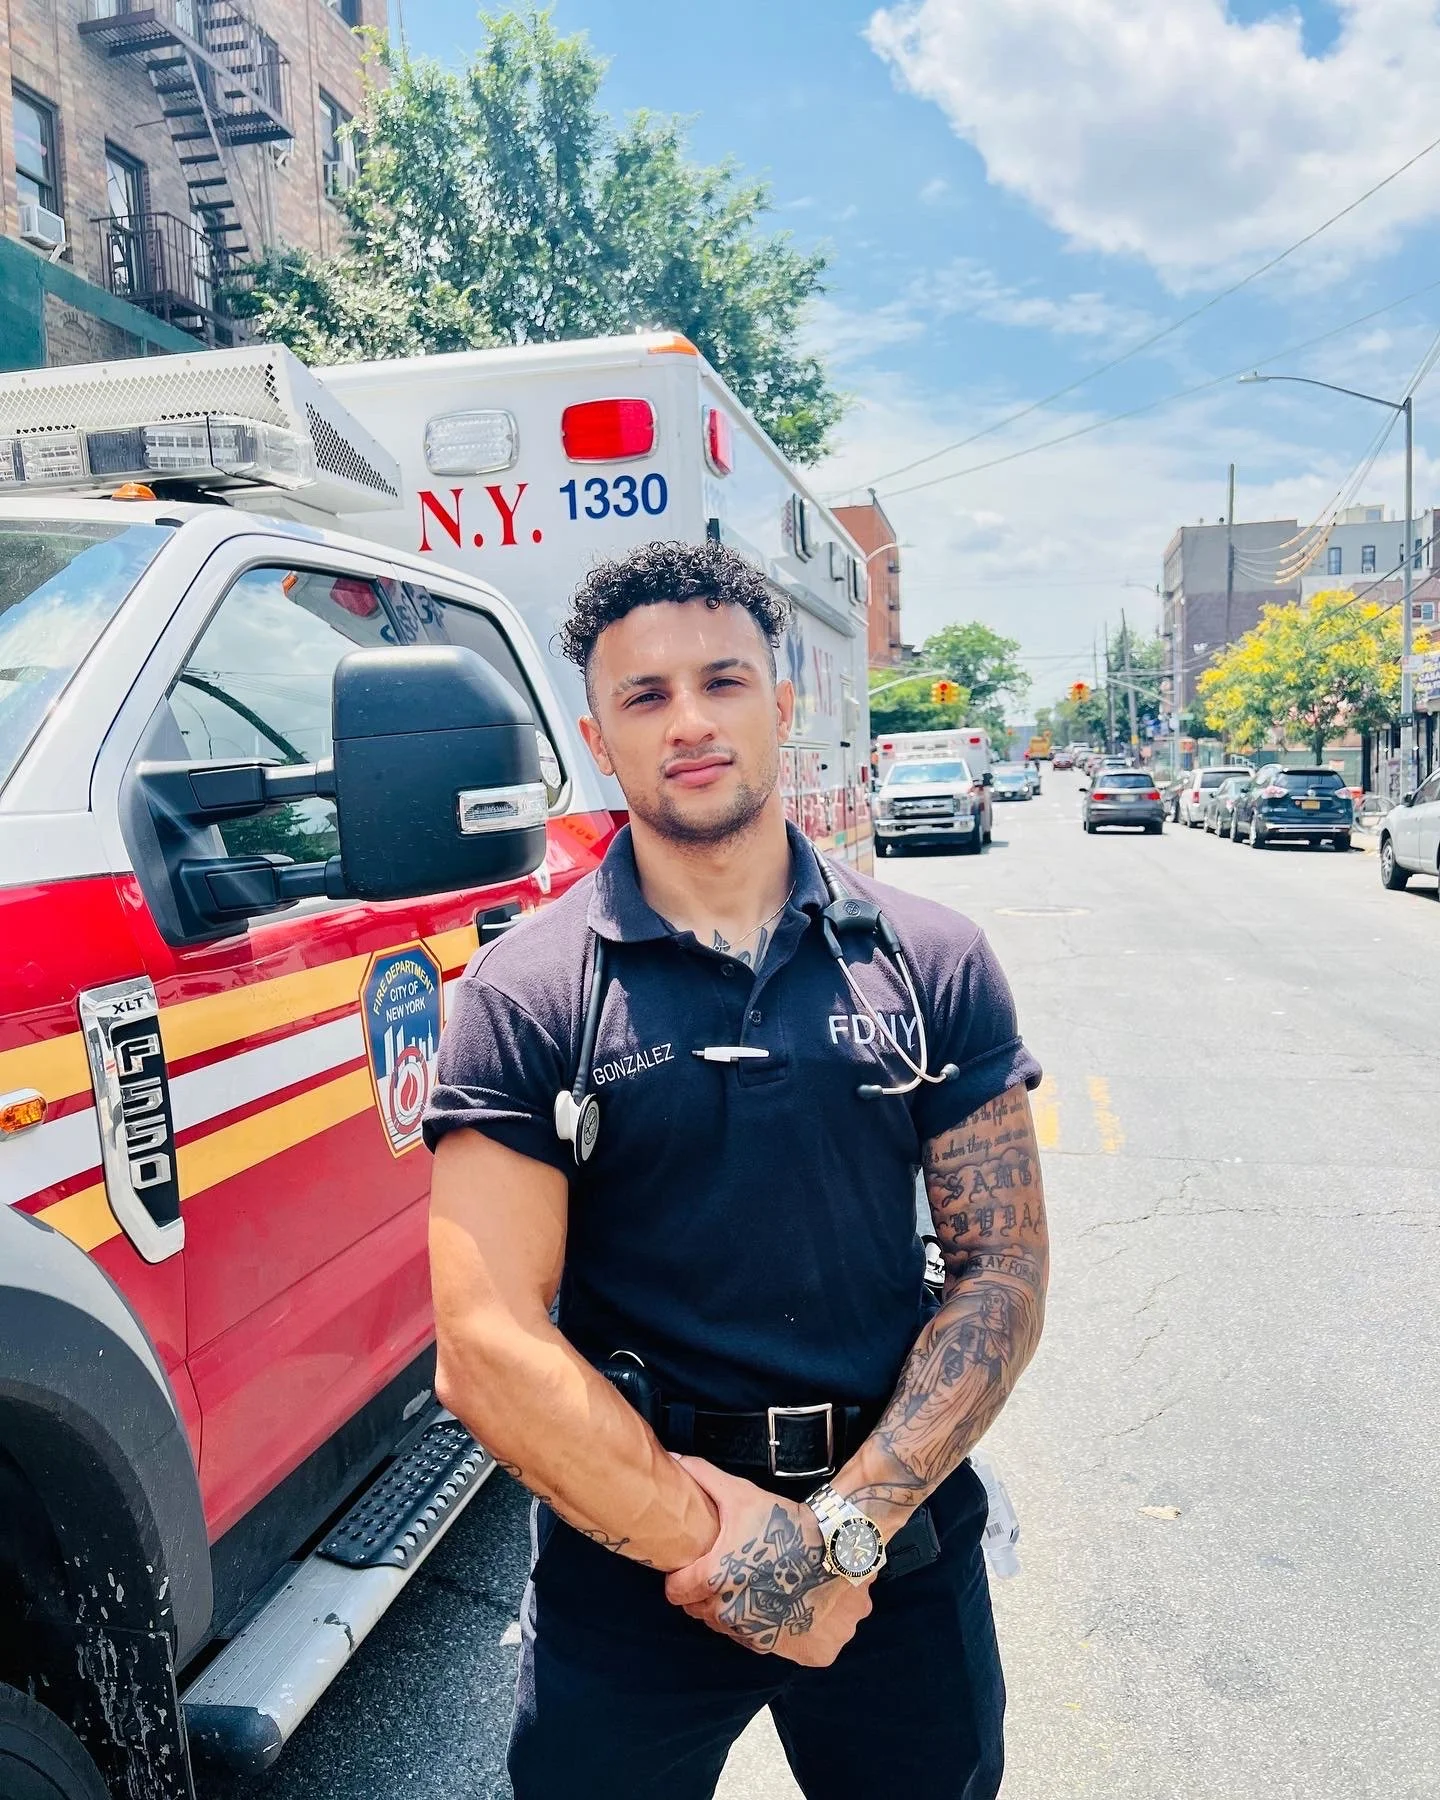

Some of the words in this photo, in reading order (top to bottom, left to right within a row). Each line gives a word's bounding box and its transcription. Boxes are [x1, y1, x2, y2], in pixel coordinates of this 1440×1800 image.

[559, 473, 668, 520] 1330
[417, 482, 542, 552] N.Y.
[112, 997, 144, 1015] XLT
[373, 979, 388, 1015] FIRE
[385, 960, 435, 995] DEPARTMENT
[390, 984, 407, 1002] CITY
[408, 980, 419, 996] OF
[386, 1004, 404, 1023] NEW
[405, 996, 426, 1015] YORK
[828, 1012, 917, 1050] FDNY
[592, 1043, 675, 1085] GONZALEZ
